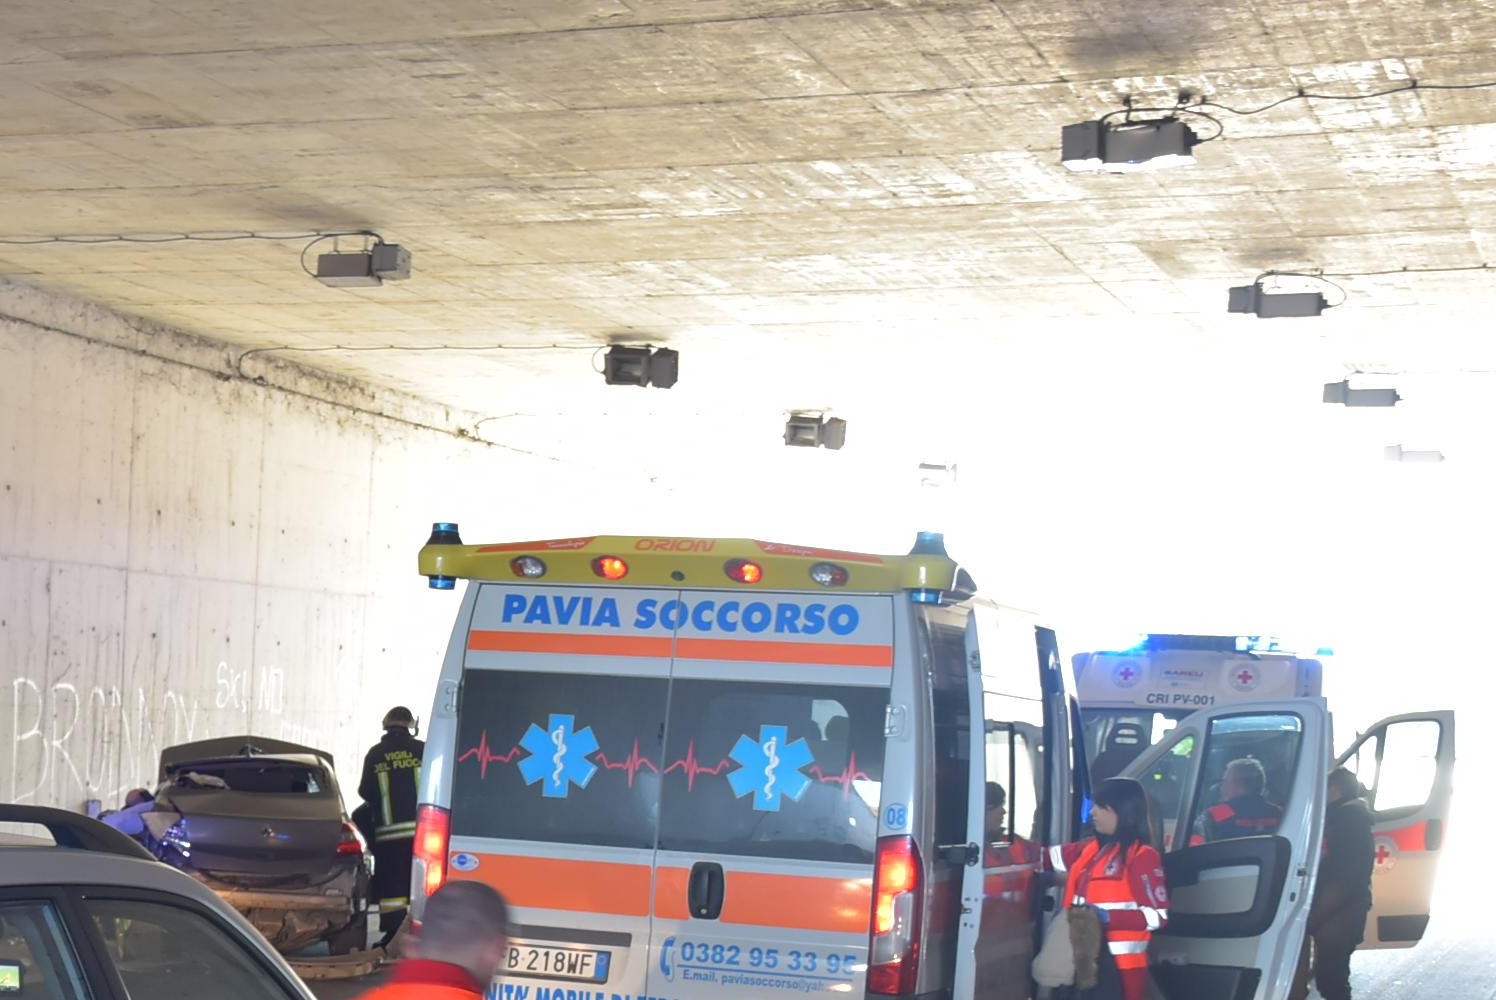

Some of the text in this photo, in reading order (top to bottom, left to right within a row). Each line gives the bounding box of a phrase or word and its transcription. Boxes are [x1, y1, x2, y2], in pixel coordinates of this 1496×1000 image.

[634, 539, 717, 552] ORION
[502, 594, 859, 635] PAVIA SOCCORSO
[1146, 693, 1216, 706] CRI PV-001
[887, 807, 906, 826] 08
[525, 949, 593, 976] 218WF
[680, 941, 741, 967] 0382
[749, 947, 779, 970] 95
[787, 950, 817, 972] 33
